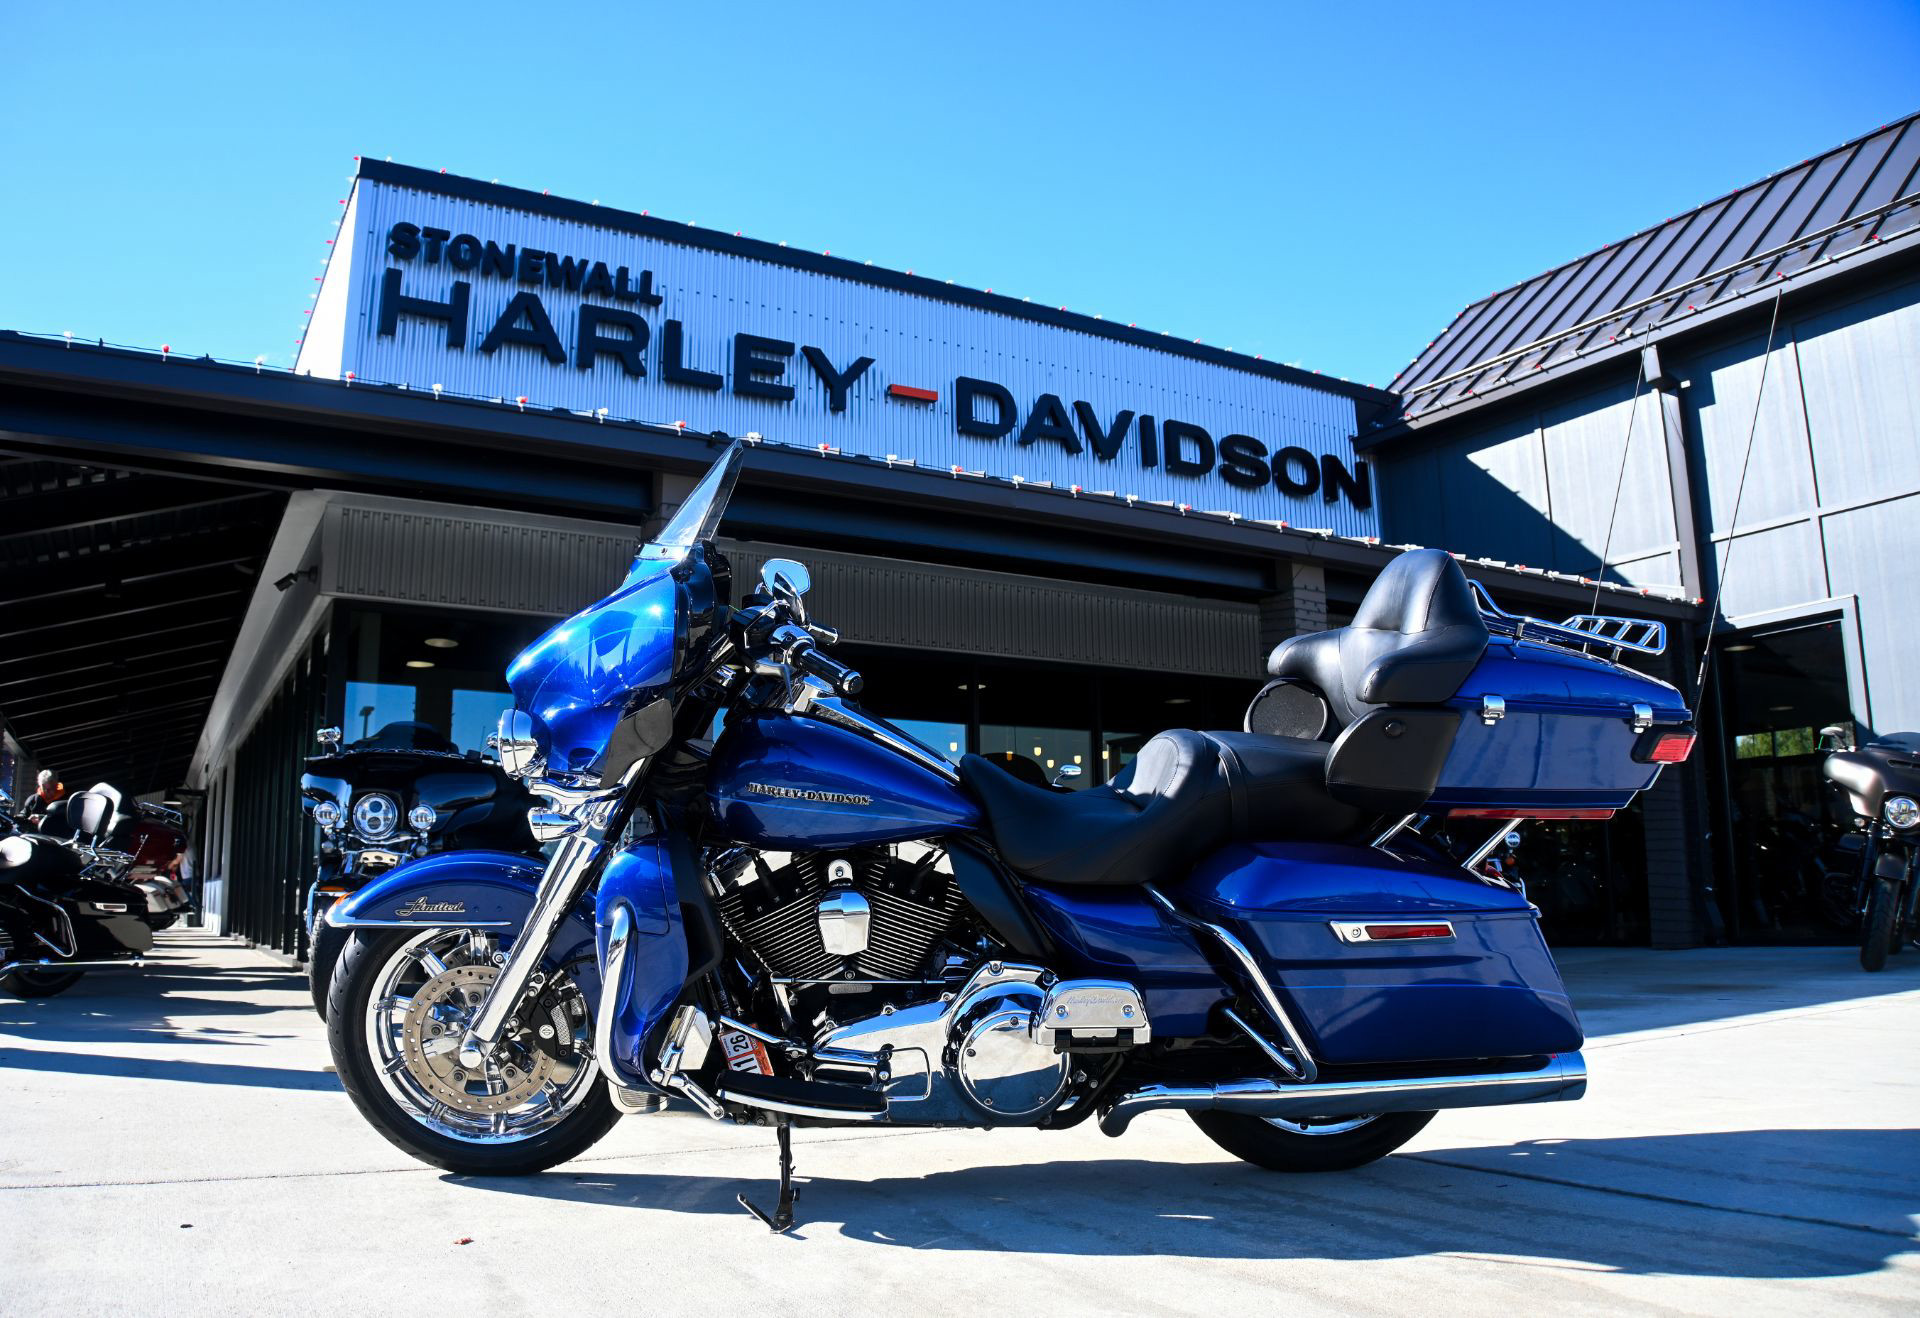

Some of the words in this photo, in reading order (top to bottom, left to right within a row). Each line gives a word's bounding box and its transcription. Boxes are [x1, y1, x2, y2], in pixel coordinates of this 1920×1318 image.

[388, 222, 663, 307] STONEWALL
[395, 896, 466, 916] Limited
[730, 1034, 749, 1052] 26
